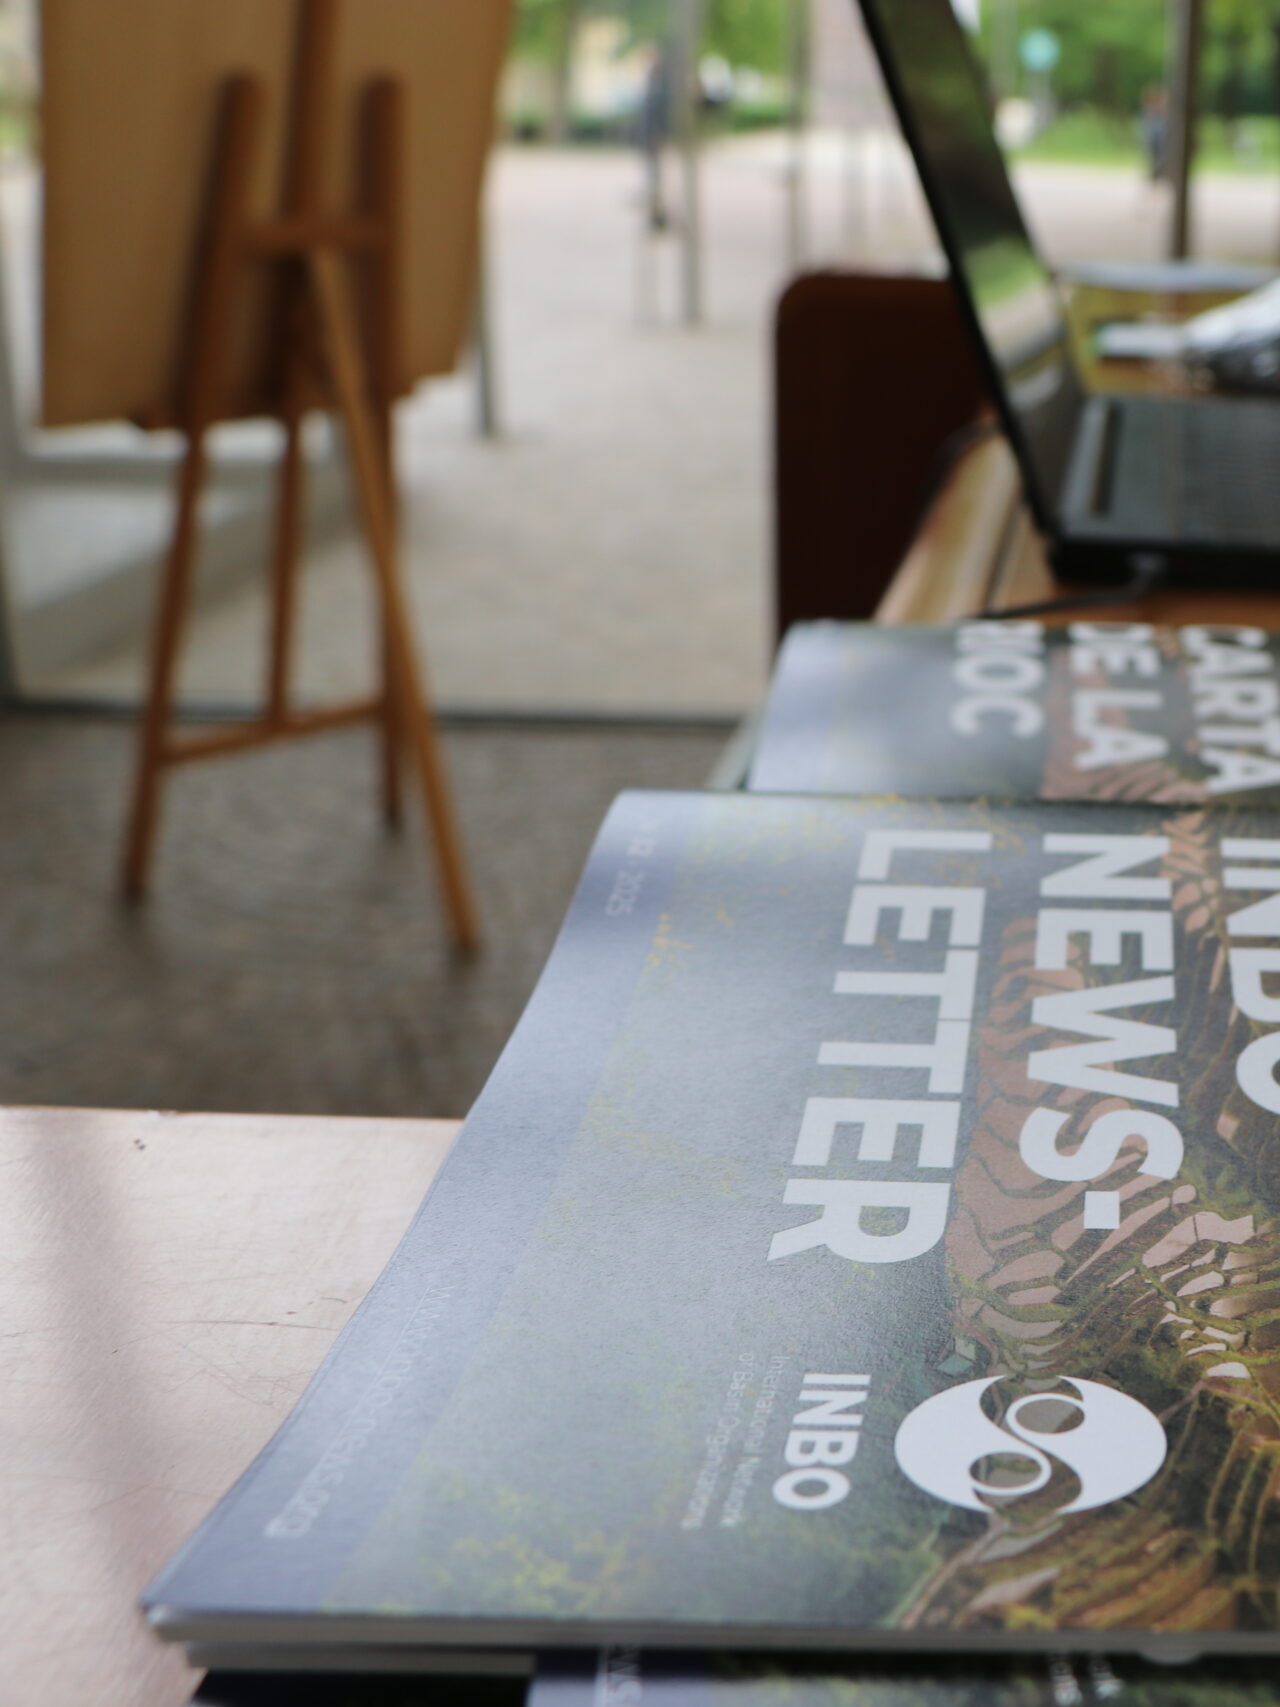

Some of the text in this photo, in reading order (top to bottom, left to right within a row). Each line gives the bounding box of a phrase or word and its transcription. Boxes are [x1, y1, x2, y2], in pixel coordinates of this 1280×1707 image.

[1071, 689, 1170, 770] LA
[766, 829, 993, 1264] LETTER
[1018, 833, 1185, 1230] NEWS-
[723, 1371, 747, 1409] Basin
[738, 1352, 755, 1380] of
[719, 1354, 791, 1528] International Network
[772, 1372, 872, 1511] INBO
